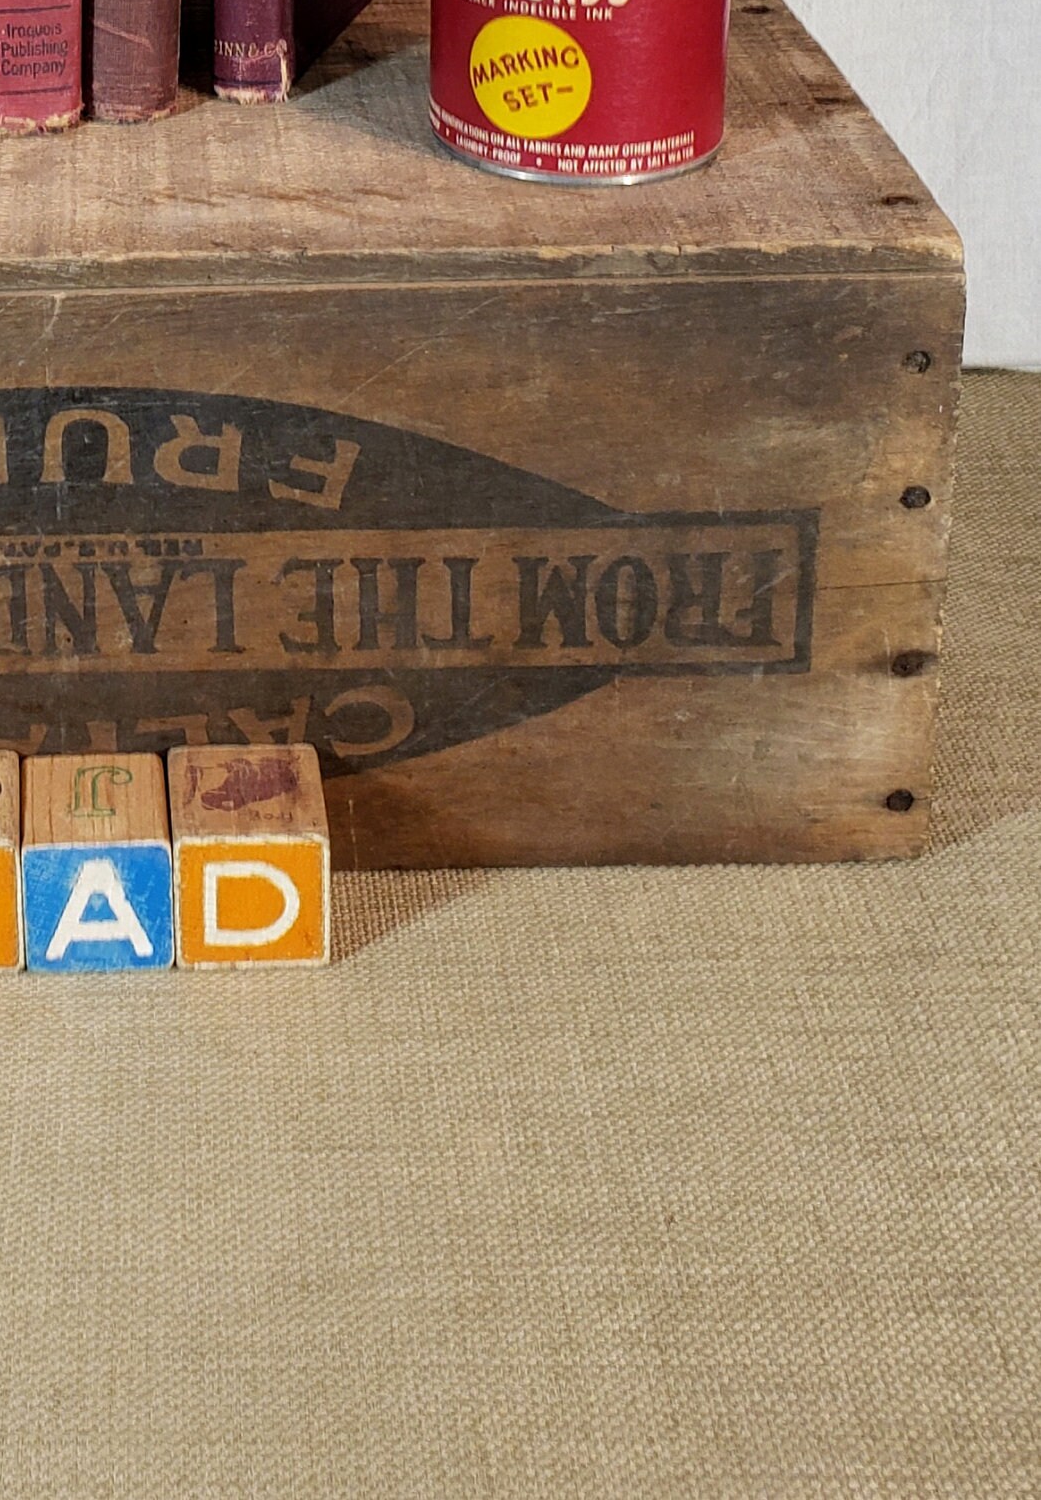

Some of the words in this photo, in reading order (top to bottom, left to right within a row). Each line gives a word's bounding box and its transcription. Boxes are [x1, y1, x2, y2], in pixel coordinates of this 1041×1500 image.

[586, 6, 613, 21] INK
[5, 23, 63, 40] Iroquois
[0, 40, 69, 59] Publishing
[0, 59, 67, 80] Company
[490, 132, 505, 148] ON
[506, 135, 521, 151] ALL
[523, 138, 561, 157] FABRICS
[564, 143, 586, 158] AND
[588, 144, 619, 158] MANY
[622, 141, 651, 157] OTHER
[492, 148, 522, 165] PROOF
[557, 159, 578, 172] NOT
[630, 156, 643, 171] BY
[278, 555, 492, 655] THE
[511, 547, 784, 650] FROM
